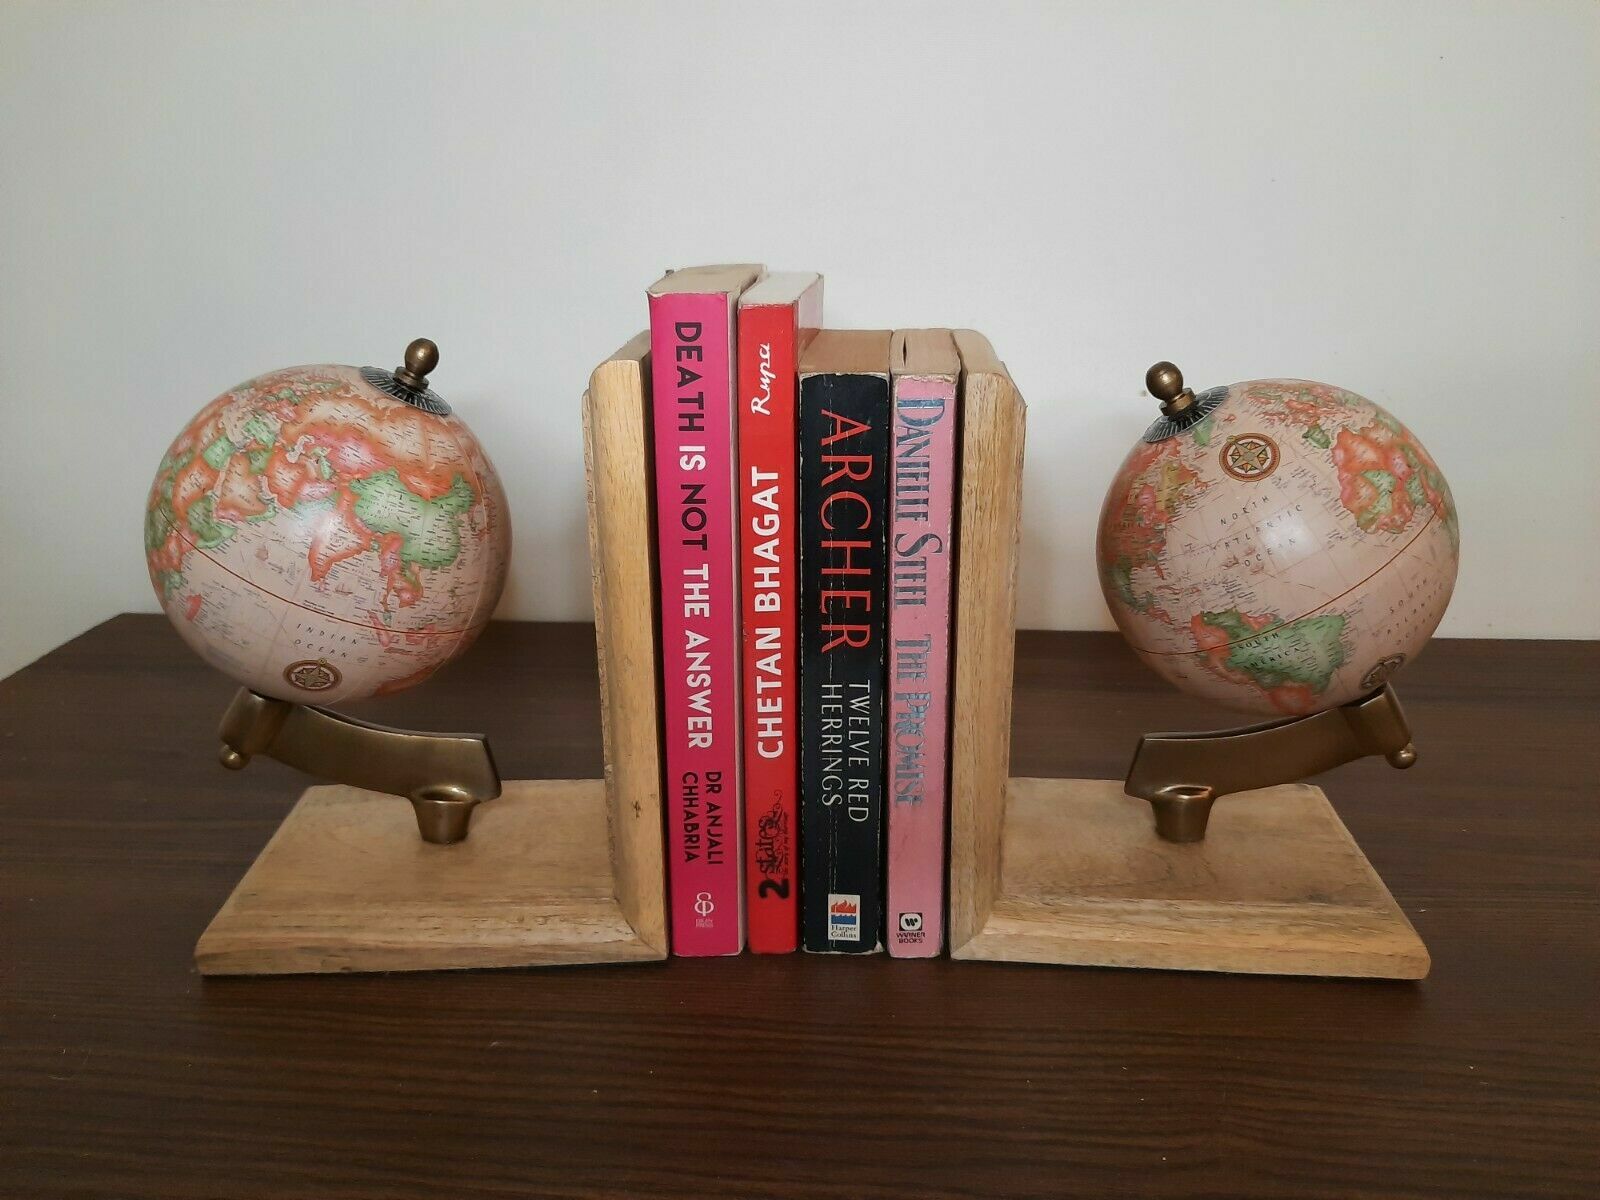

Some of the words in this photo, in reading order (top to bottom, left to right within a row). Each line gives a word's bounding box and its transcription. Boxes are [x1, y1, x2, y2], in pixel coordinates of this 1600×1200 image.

[674, 321, 706, 432] DEATH
[751, 342, 777, 415] Rupa
[679, 445, 707, 471] IS
[680, 483, 708, 551] NOT
[751, 466, 781, 612] BHAGAT
[820, 408, 873, 653] ARCHER
[1220, 496, 1269, 525] NORTH
[683, 563, 710, 618] THE
[294, 639, 348, 658] OCEAN
[297, 623, 357, 646] INDIAN
[685, 630, 713, 749] ANSWER
[756, 627, 784, 759] CHETAN
[821, 684, 843, 806] HERRINGS
[848, 680, 870, 767] TWELVE
[705, 771, 722, 794] DR
[848, 778, 869, 823] RED
[682, 772, 701, 863] CHHABRIA
[706, 802, 724, 865] ANJALI
[758, 879, 790, 899] 2
[831, 924, 857, 932] Harper
[831, 931, 857, 939] Collins
